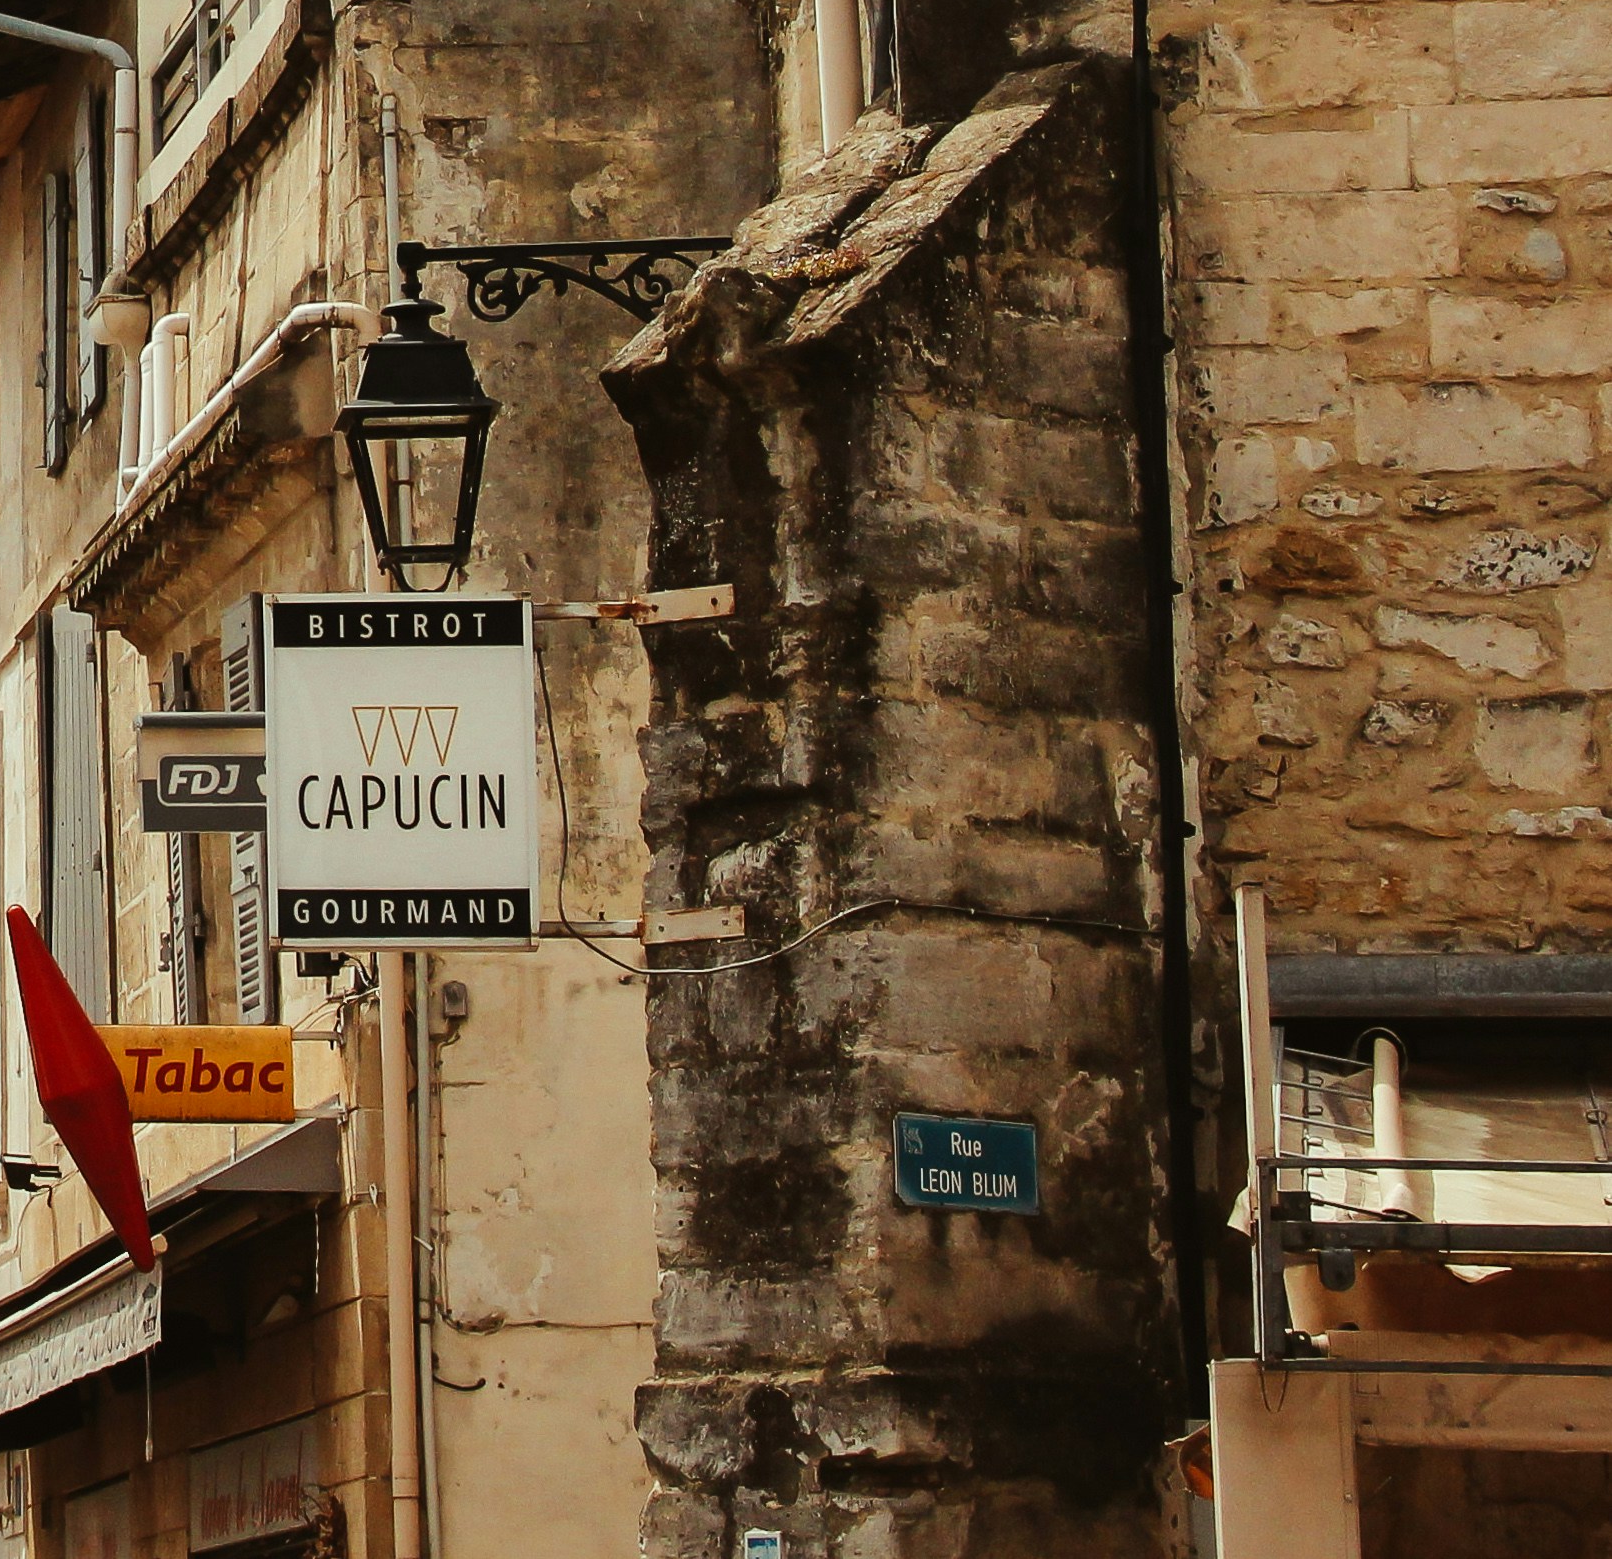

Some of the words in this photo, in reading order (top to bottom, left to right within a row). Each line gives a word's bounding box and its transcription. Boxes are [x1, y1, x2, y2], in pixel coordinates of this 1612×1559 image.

[309, 613, 486, 638] BISTROT
[168, 764, 240, 795] FDJ
[297, 774, 506, 830] CAPUCIN
[293, 898, 515, 924] GOURMAND
[125, 1047, 285, 1094] Tabac
[950, 1131, 982, 1157] Rue
[920, 1167, 962, 1194] LEON
[972, 1172, 1017, 1198] BLUM
